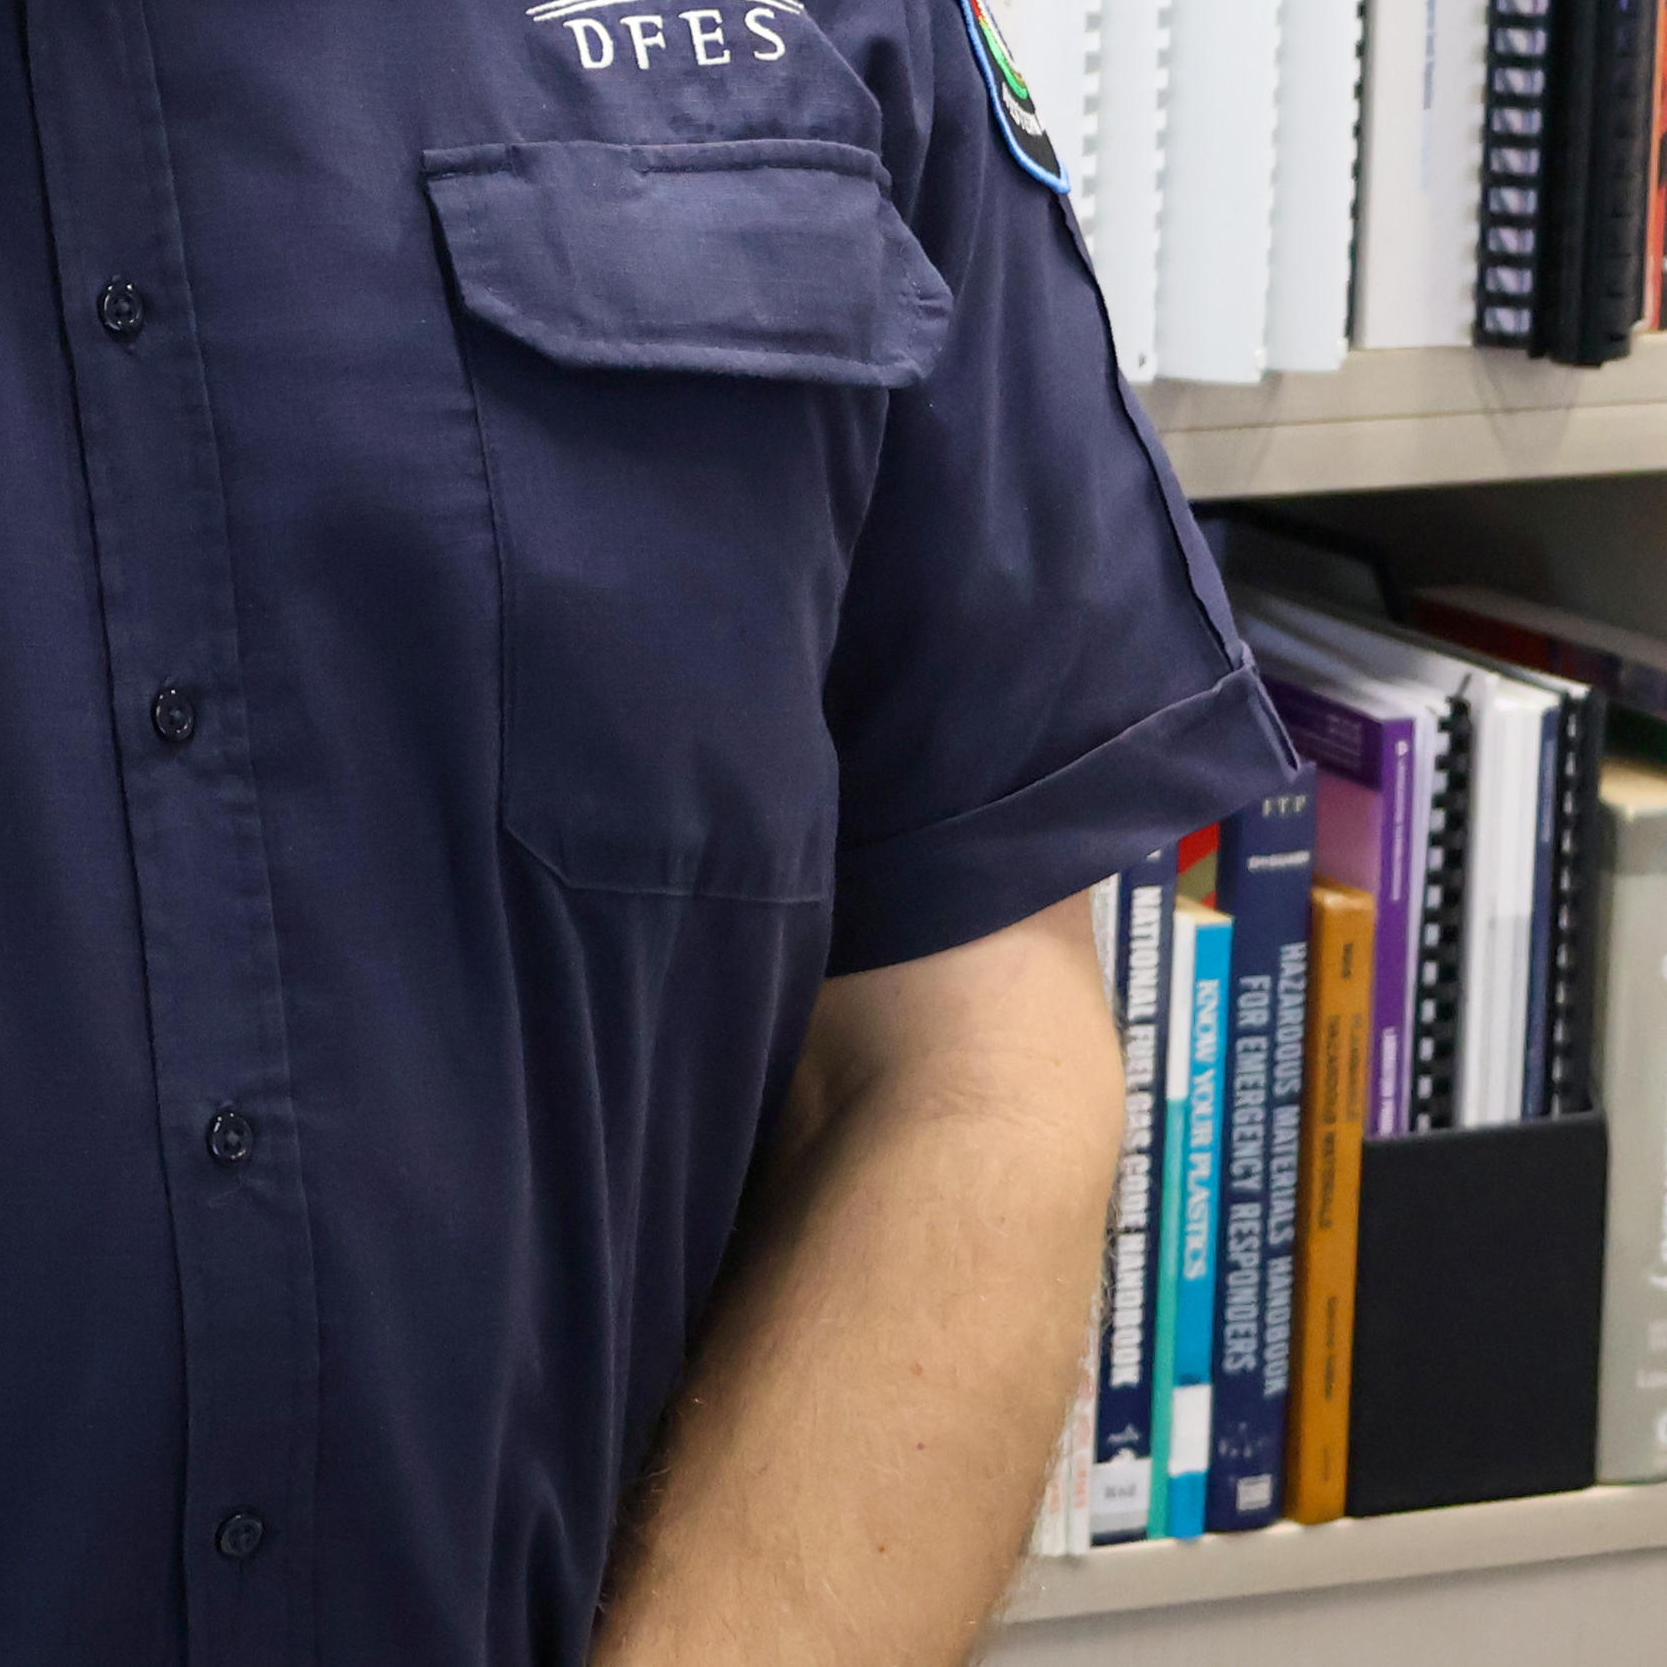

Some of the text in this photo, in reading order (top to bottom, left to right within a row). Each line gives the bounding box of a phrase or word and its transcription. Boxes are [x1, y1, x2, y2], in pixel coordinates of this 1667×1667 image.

[563, 7, 786, 70] DFES
[1182, 980, 1220, 1279] KNOW YOUR PLASTICS
[1222, 975, 1271, 1373] FOR EMERGENCY RESPONDERS
[1262, 943, 1308, 1397] HAZARDOUS MATERIALS HANDBOOK
